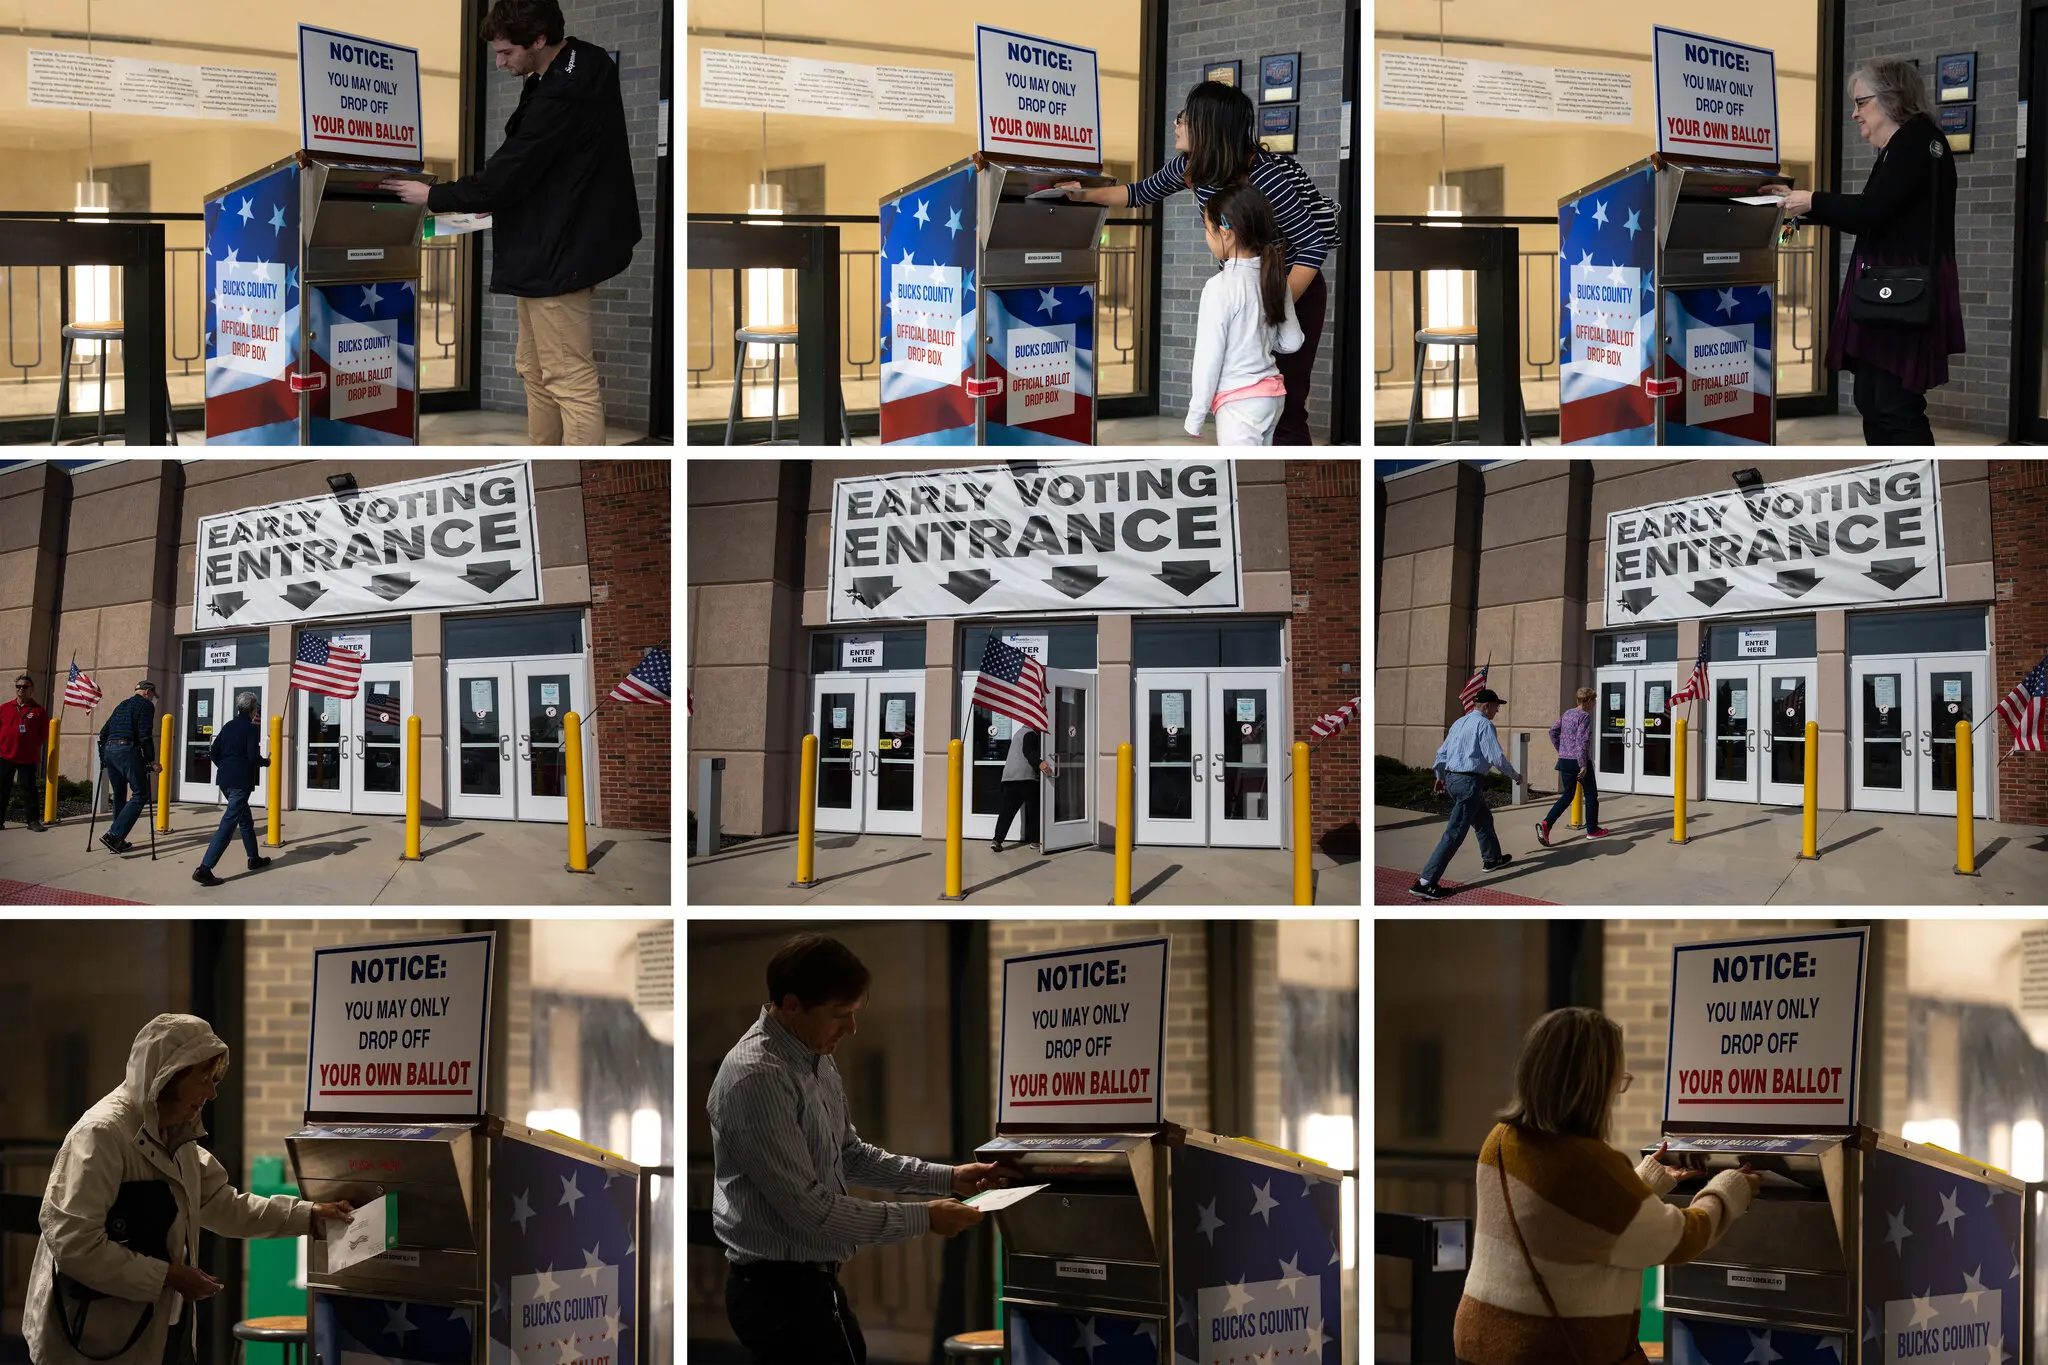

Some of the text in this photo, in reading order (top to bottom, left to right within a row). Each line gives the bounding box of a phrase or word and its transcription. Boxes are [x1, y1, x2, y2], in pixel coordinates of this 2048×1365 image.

[330, 42, 393, 70] NOTICE:
[1008, 42, 1072, 71] NOTICE:
[1686, 44, 1749, 72] NOTICE:
[328, 72, 397, 95] YOU MAY ONLY
[1006, 72, 1076, 96] YOU MAY ONLY
[1683, 73, 1753, 97] YOU MAY ONLY
[341, 96, 388, 114] DROP OFF
[1019, 97, 1066, 115] DROP OFF
[1696, 98, 1744, 116] DROP OFF
[312, 115, 414, 141] YOUR OWN BALLOT
[990, 116, 1092, 144] YOUR OWN BALLOT
[1667, 117, 1770, 144] YOUR OWN BALLOT
[223, 280, 277, 299] BUCKS COUNTY
[898, 284, 953, 303] BUCKS COUNTY
[1578, 284, 1632, 303] BUCKS COUNTY
[222, 320, 279, 342] OFFICIAL BALLOT
[897, 324, 955, 346] OFFICIAL BALLOT
[1576, 324, 1634, 347] OFFICIAL BALLOT
[233, 342, 266, 361] DROP BOX
[339, 336, 390, 353] BUCKS COUNTY
[908, 346, 942, 366] DROP BOX
[1016, 340, 1068, 358] BUCKS COUNTY
[1587, 346, 1621, 366] DROP BOX
[1694, 340, 1747, 358] BUCKS COUNTY
[336, 367, 392, 386] OFFICIAL BALLOT
[1013, 372, 1070, 392] OFFICIAL BALLOT
[1692, 372, 1749, 391] OFFICIAL BALLOT
[348, 384, 381, 401] DROP BOX
[1025, 390, 1059, 406] DROP BOX
[1704, 390, 1738, 406] DROP BOX
[848, 464, 1217, 520] EARLY VOTING
[208, 477, 518, 548] EARLY VOTING
[1618, 472, 1922, 545] EARLY VOTING
[844, 506, 1221, 567] ENTRANCE
[1616, 508, 1926, 582] ENTRANCE
[206, 512, 521, 585] ENTRANCE
[351, 954, 446, 984] NOTICE:
[1038, 960, 1126, 992] NOTICE:
[1713, 952, 1816, 983] NOTICE:
[346, 997, 450, 1020] YOU MAY ONLY
[1033, 1003, 1129, 1029] YOU MAY ONLY
[1707, 998, 1819, 1022] YOU MAY ONLY
[359, 1029, 430, 1049] DROP OFF
[1046, 1036, 1112, 1059] DROP OFF
[1721, 1032, 1798, 1054] DROP OFF
[320, 1061, 470, 1086] YOUR OWN BALLOT
[1010, 1068, 1150, 1097] YOUR OWN BALLOT
[1679, 1067, 1842, 1094] YOUR OWN BALLOT
[523, 1295, 608, 1328] BUCKS COUNTY
[1213, 1306, 1308, 1342] BUCKS COUNTY
[1898, 1322, 1990, 1358] BUCKS COUNTY
